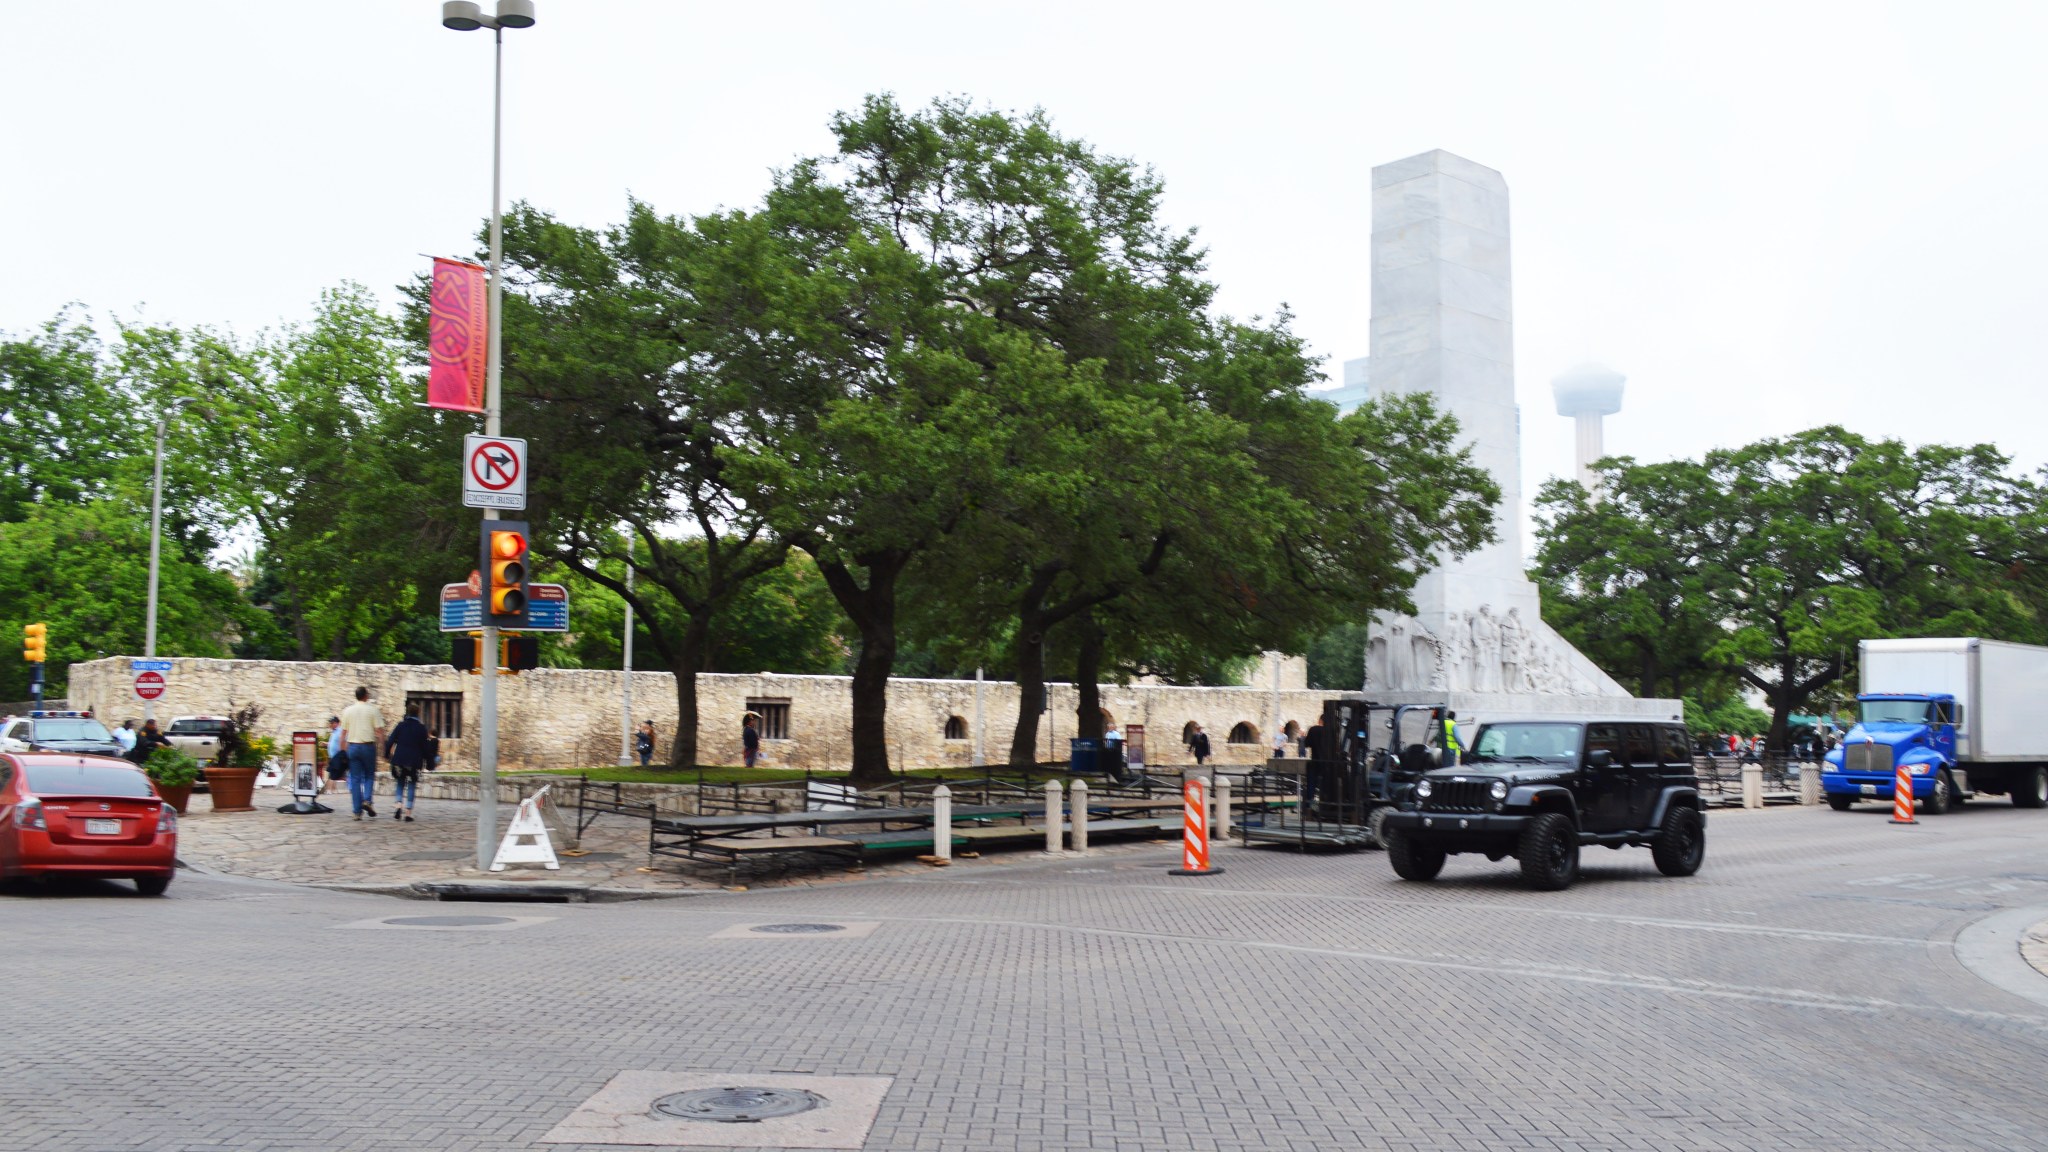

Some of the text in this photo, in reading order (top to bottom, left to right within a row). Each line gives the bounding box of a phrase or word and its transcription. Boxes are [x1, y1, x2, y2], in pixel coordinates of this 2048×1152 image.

[470, 271, 483, 407] DOWNTOWN SAN ANTONIO
[467, 493, 521, 506] EXCEPT BUSES
